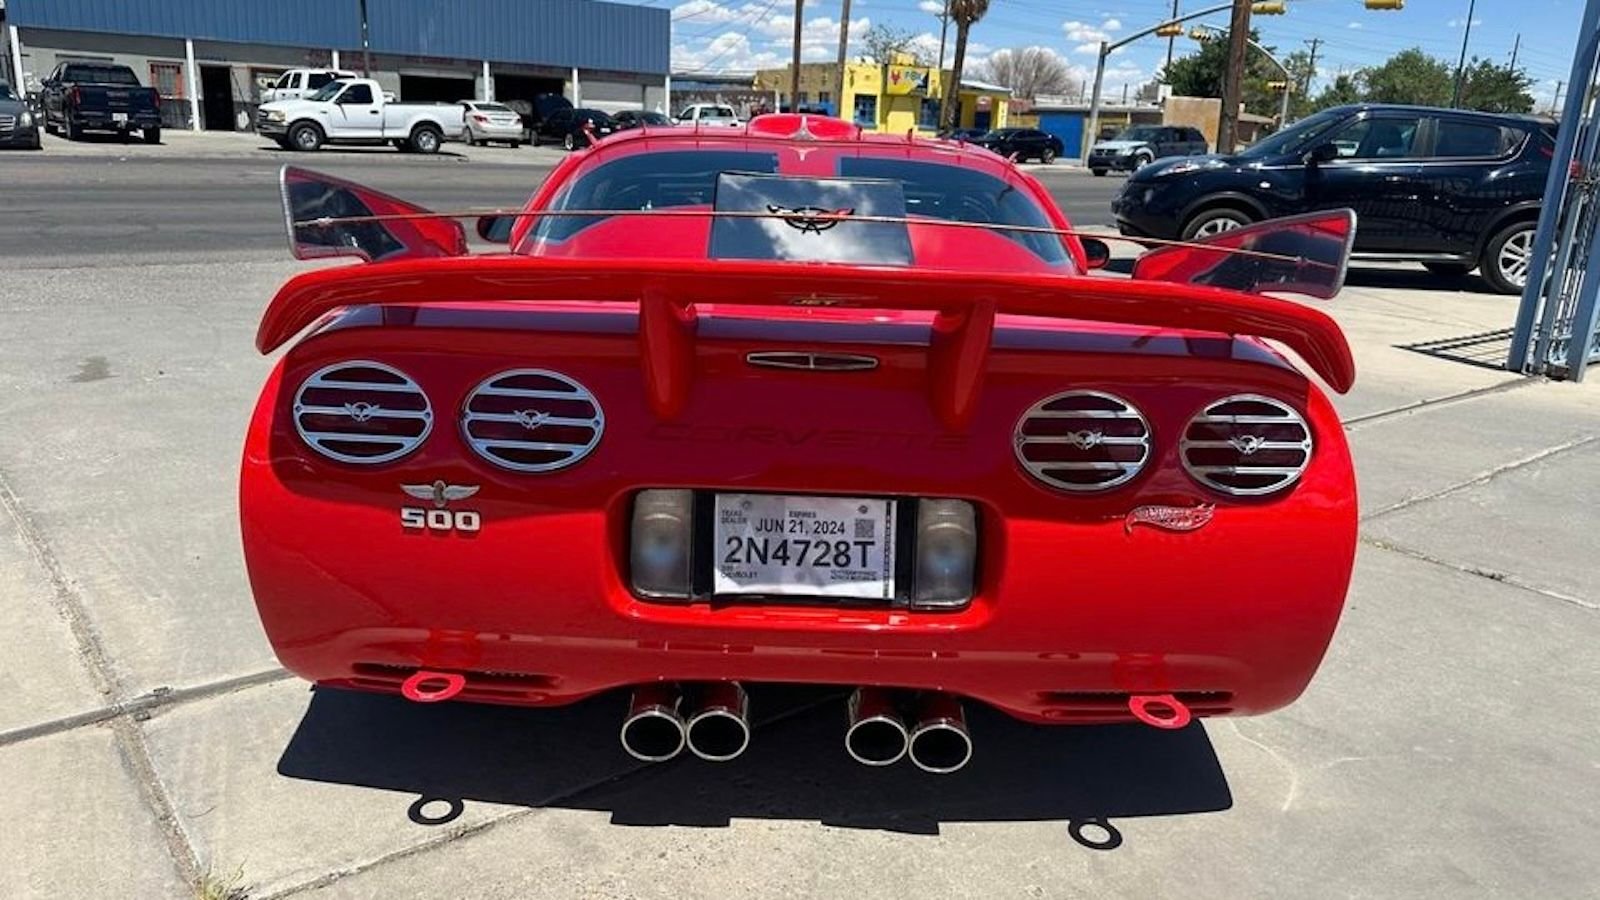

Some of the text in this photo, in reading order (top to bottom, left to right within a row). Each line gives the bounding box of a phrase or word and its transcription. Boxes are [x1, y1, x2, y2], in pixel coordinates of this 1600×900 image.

[401, 507, 480, 531] 500
[755, 518, 845, 535] JUN 21, 2024
[724, 535, 876, 569] 2N4728T
